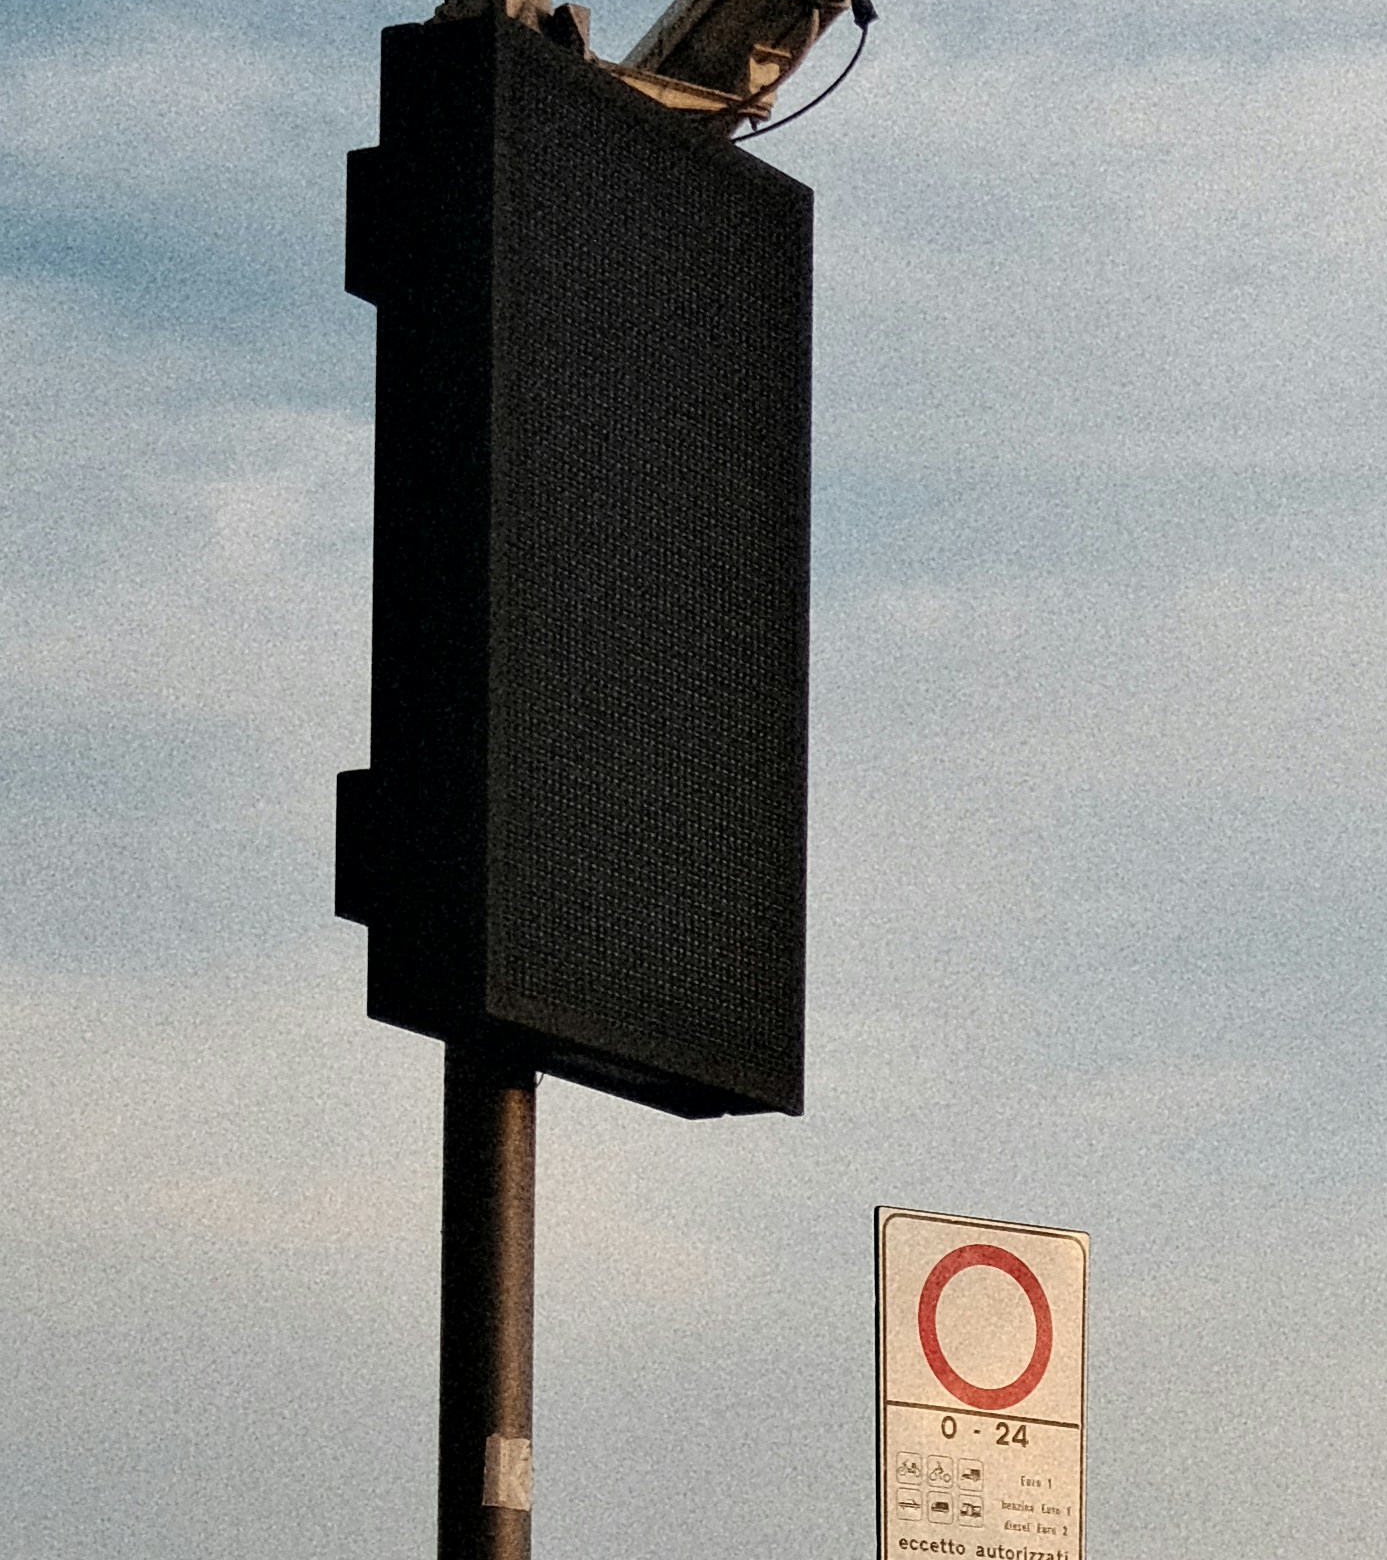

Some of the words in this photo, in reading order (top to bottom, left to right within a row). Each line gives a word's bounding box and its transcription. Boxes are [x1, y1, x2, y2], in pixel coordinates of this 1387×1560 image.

[941, 1415, 957, 1439] 0
[995, 1422, 1030, 1448] 24
[899, 1537, 966, 1555] eccetto
